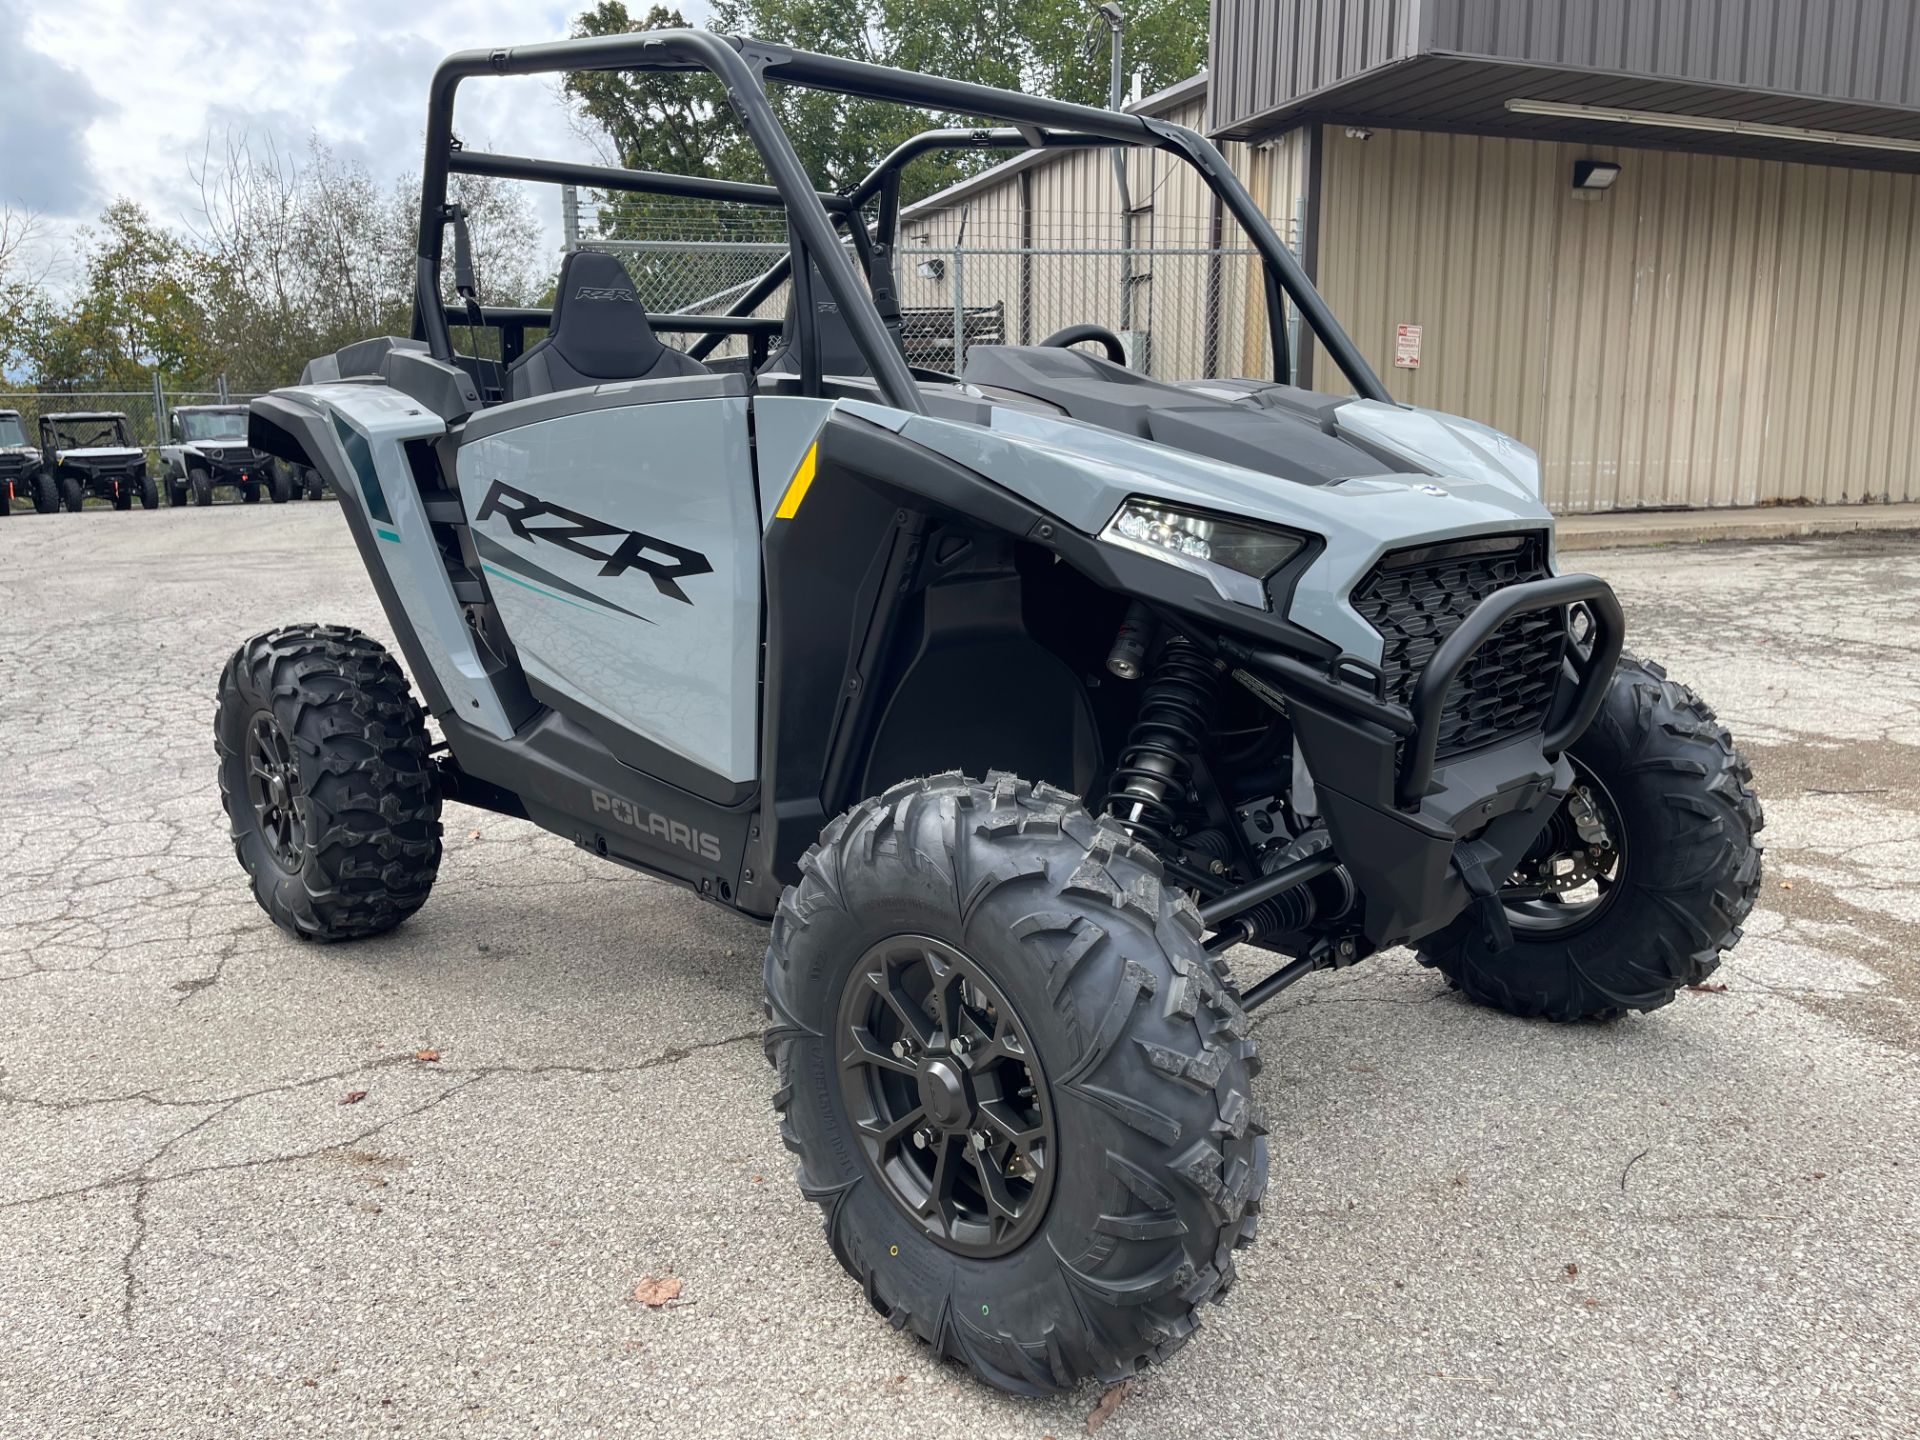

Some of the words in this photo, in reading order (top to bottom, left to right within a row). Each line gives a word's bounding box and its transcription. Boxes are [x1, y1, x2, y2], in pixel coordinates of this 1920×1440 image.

[575, 286, 633, 301] RZR
[475, 479, 714, 606] RZR
[591, 789, 721, 862] POLARIS
